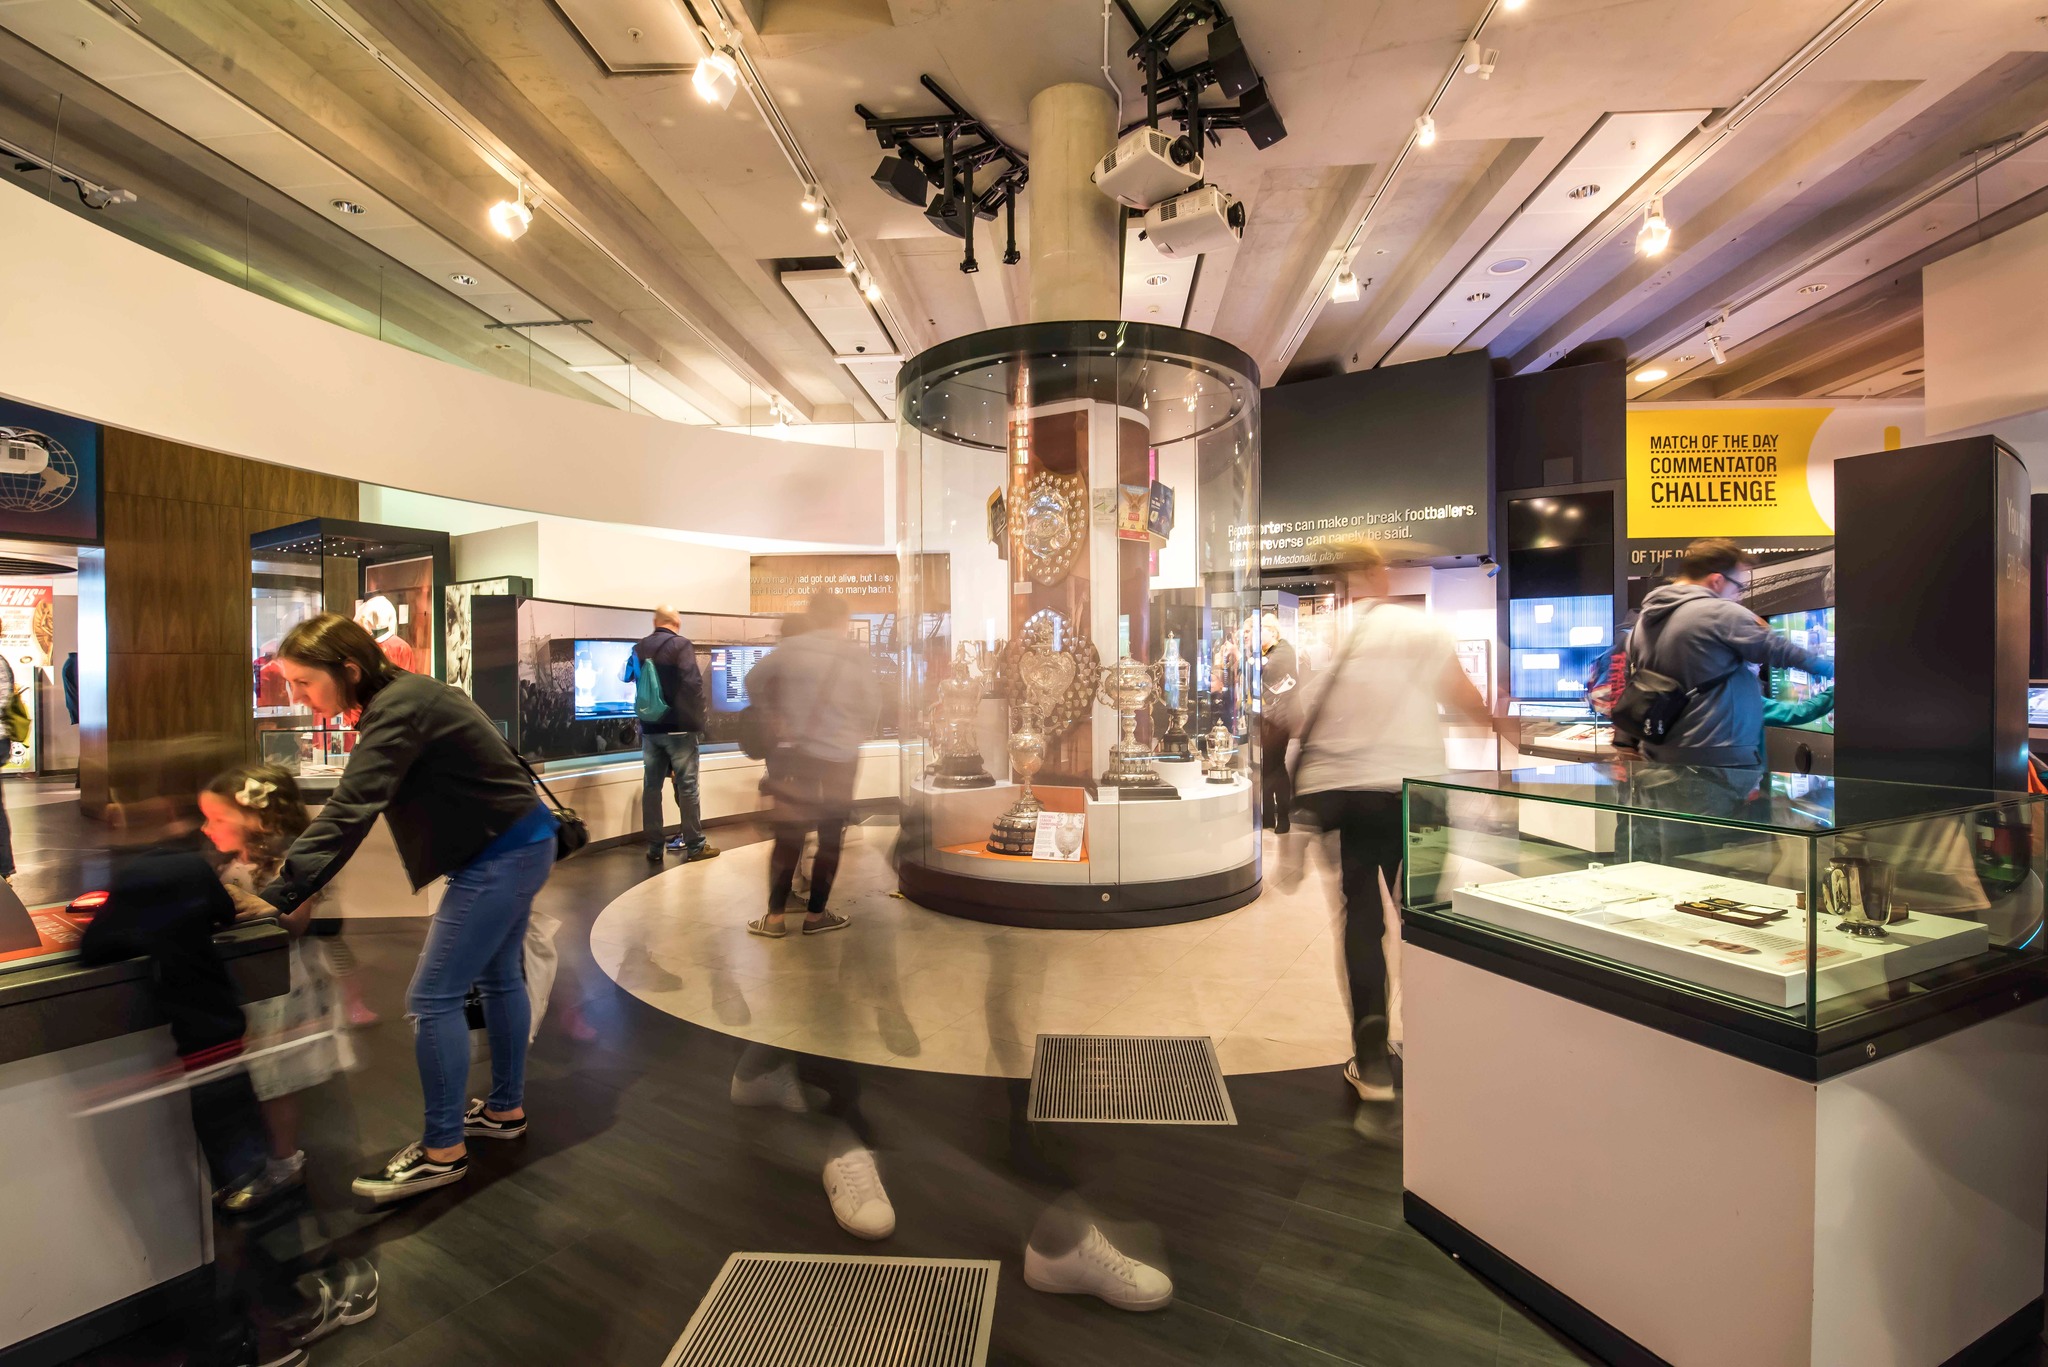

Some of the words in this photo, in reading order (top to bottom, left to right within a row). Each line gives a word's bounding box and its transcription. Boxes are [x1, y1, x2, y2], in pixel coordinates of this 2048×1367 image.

[1650, 436, 1698, 450] MATCH
[1702, 434, 1718, 449] OF
[1724, 434, 1748, 448] THE
[1752, 434, 1778, 448] DAY
[1650, 456, 1776, 474] COMMENTATOR
[1652, 480, 1776, 504] CHALLENGE
[1294, 520, 1315, 532] can
[1317, 516, 1348, 529] make
[1350, 516, 1364, 526] or
[1366, 510, 1402, 525] break
[1405, 504, 1478, 522] footballers.
[1260, 537, 1304, 551] reverse
[1306, 534, 1326, 546] can
[1328, 530, 1365, 544] rarely
[1367, 529, 1382, 540] be
[1384, 526, 1413, 540] said.
[1319, 552, 1346, 564] player
[1631, 550, 1647, 564] OF
[1649, 550, 1672, 563] THE
[772, 576, 794, 585] many
[796, 574, 809, 584] had
[810, 574, 823, 585] got
[824, 574, 836, 582] out
[838, 574, 858, 584] alive,
[860, 574, 872, 582] but
[0, 588, 38, 606] NEWS
[798, 586, 810, 595] out
[834, 586, 844, 594] so
[846, 586, 867, 596] many
